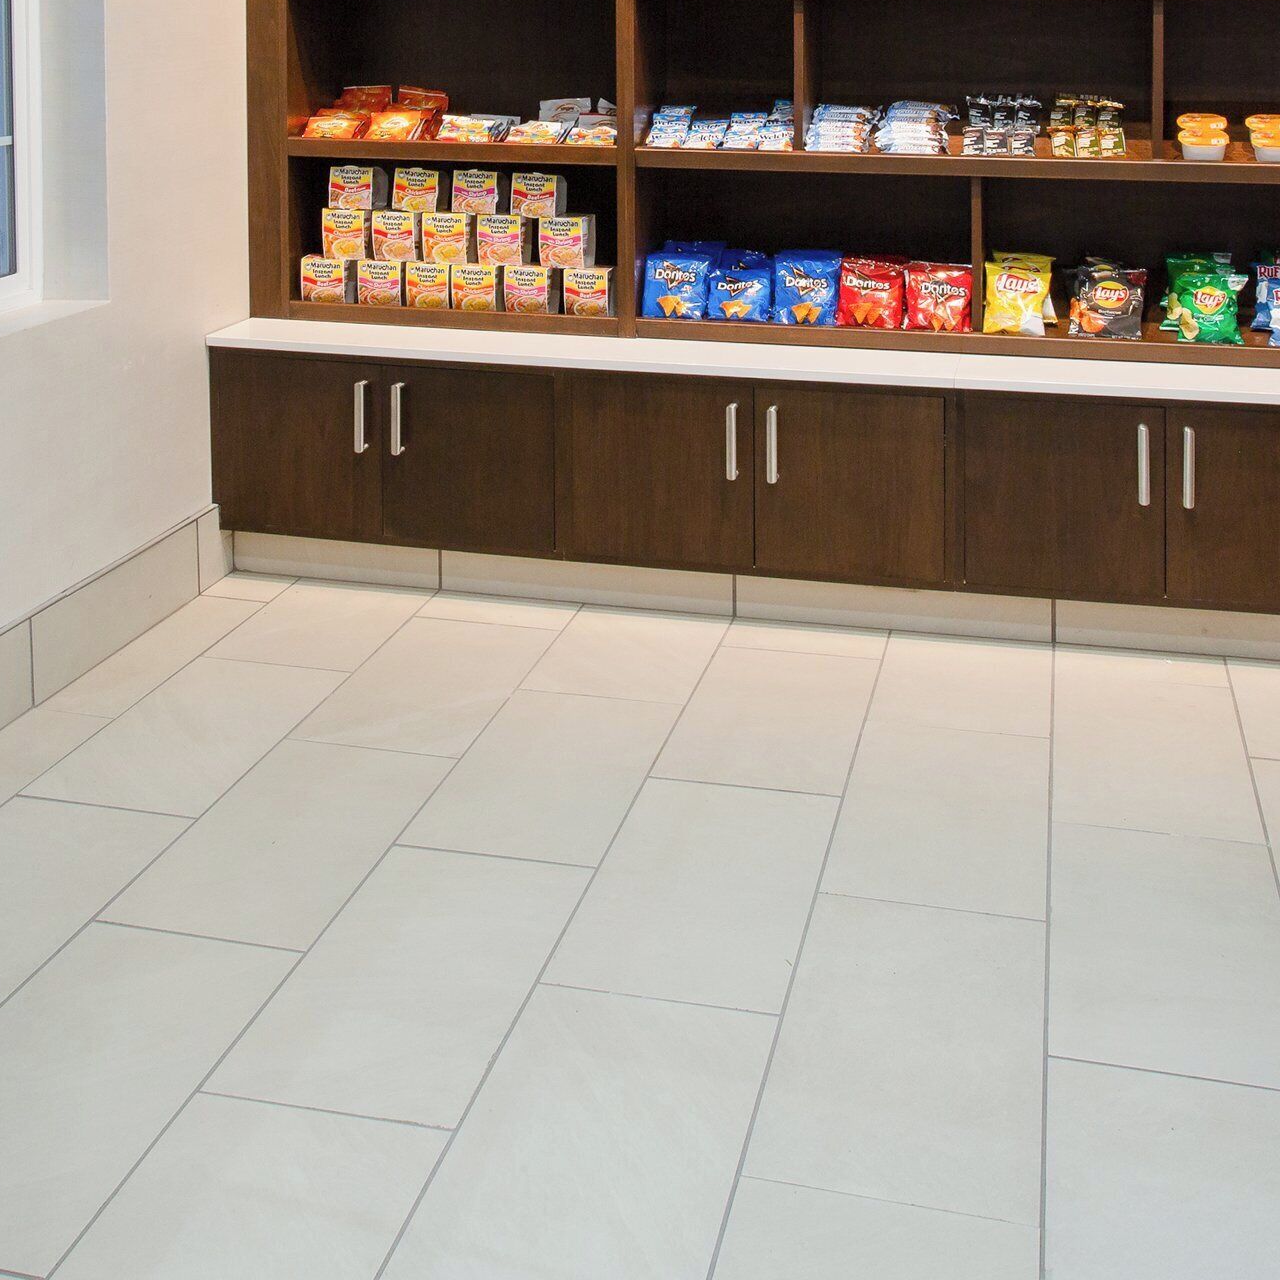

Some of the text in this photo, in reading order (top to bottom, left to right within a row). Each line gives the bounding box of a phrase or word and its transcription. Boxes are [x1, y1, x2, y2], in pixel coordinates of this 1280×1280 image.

[654, 268, 697, 283] Doritos
[717, 278, 760, 291] Doritos
[786, 276, 829, 290] Doritos
[846, 276, 891, 290] Doritos
[921, 281, 967, 296] Doritos
[1094, 285, 1127, 302] Lay's
